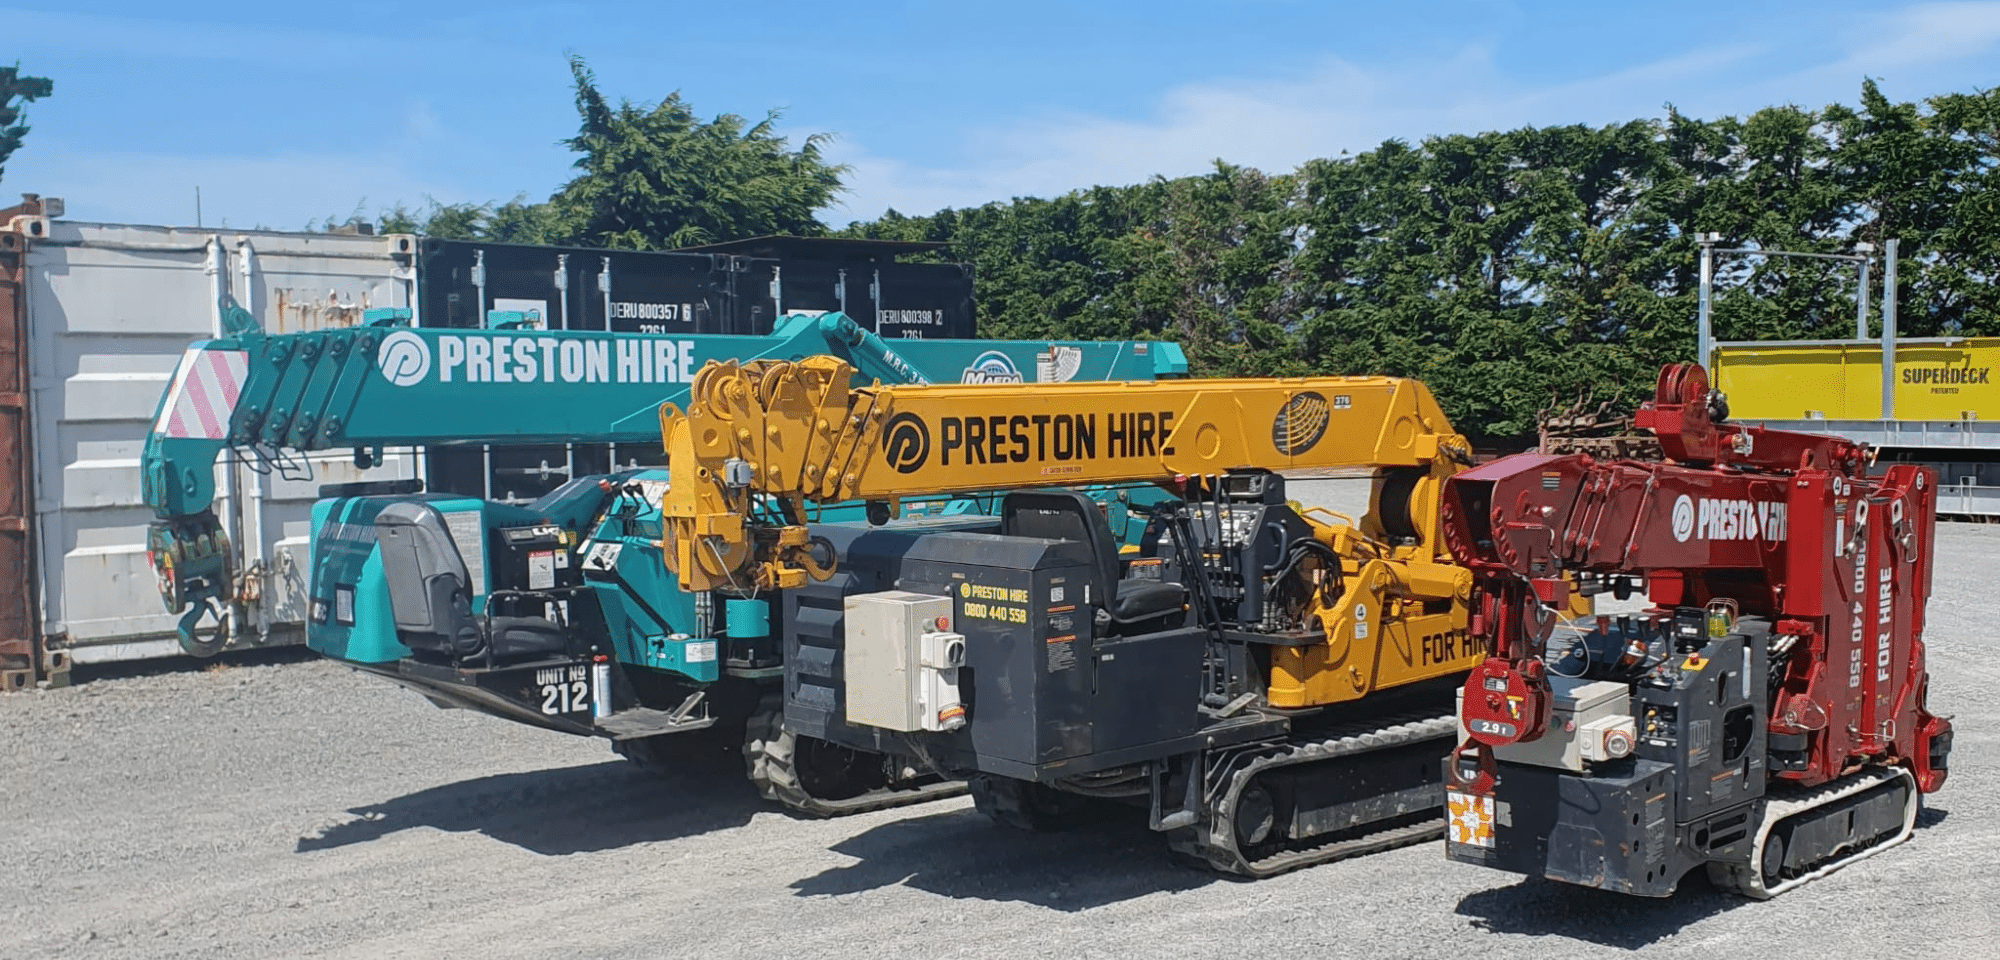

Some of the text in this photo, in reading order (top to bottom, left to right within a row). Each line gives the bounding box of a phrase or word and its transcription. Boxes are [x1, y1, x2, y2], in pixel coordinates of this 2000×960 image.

[610, 302, 691, 321] DERU 800357 6
[879, 309, 943, 325] DERU 800398 2
[438, 336, 695, 383] PRESTON HIRE
[1902, 367, 1990, 385] SUPERDECK
[940, 411, 1176, 466] PRESTON HIRE
[971, 585, 1029, 604] PRESTON HIRE
[964, 602, 988, 619] 0800
[988, 605, 1007, 621] 440
[1008, 607, 1028, 624] 558
[1851, 601, 1863, 642] 440
[1877, 567, 1893, 682] FOR HIRE
[1422, 632, 1456, 667] FOR
[536, 667, 566, 686] UNIT
[1849, 648, 1862, 688] 558
[541, 681, 589, 716] 212
[1482, 721, 1500, 734] 2.9
